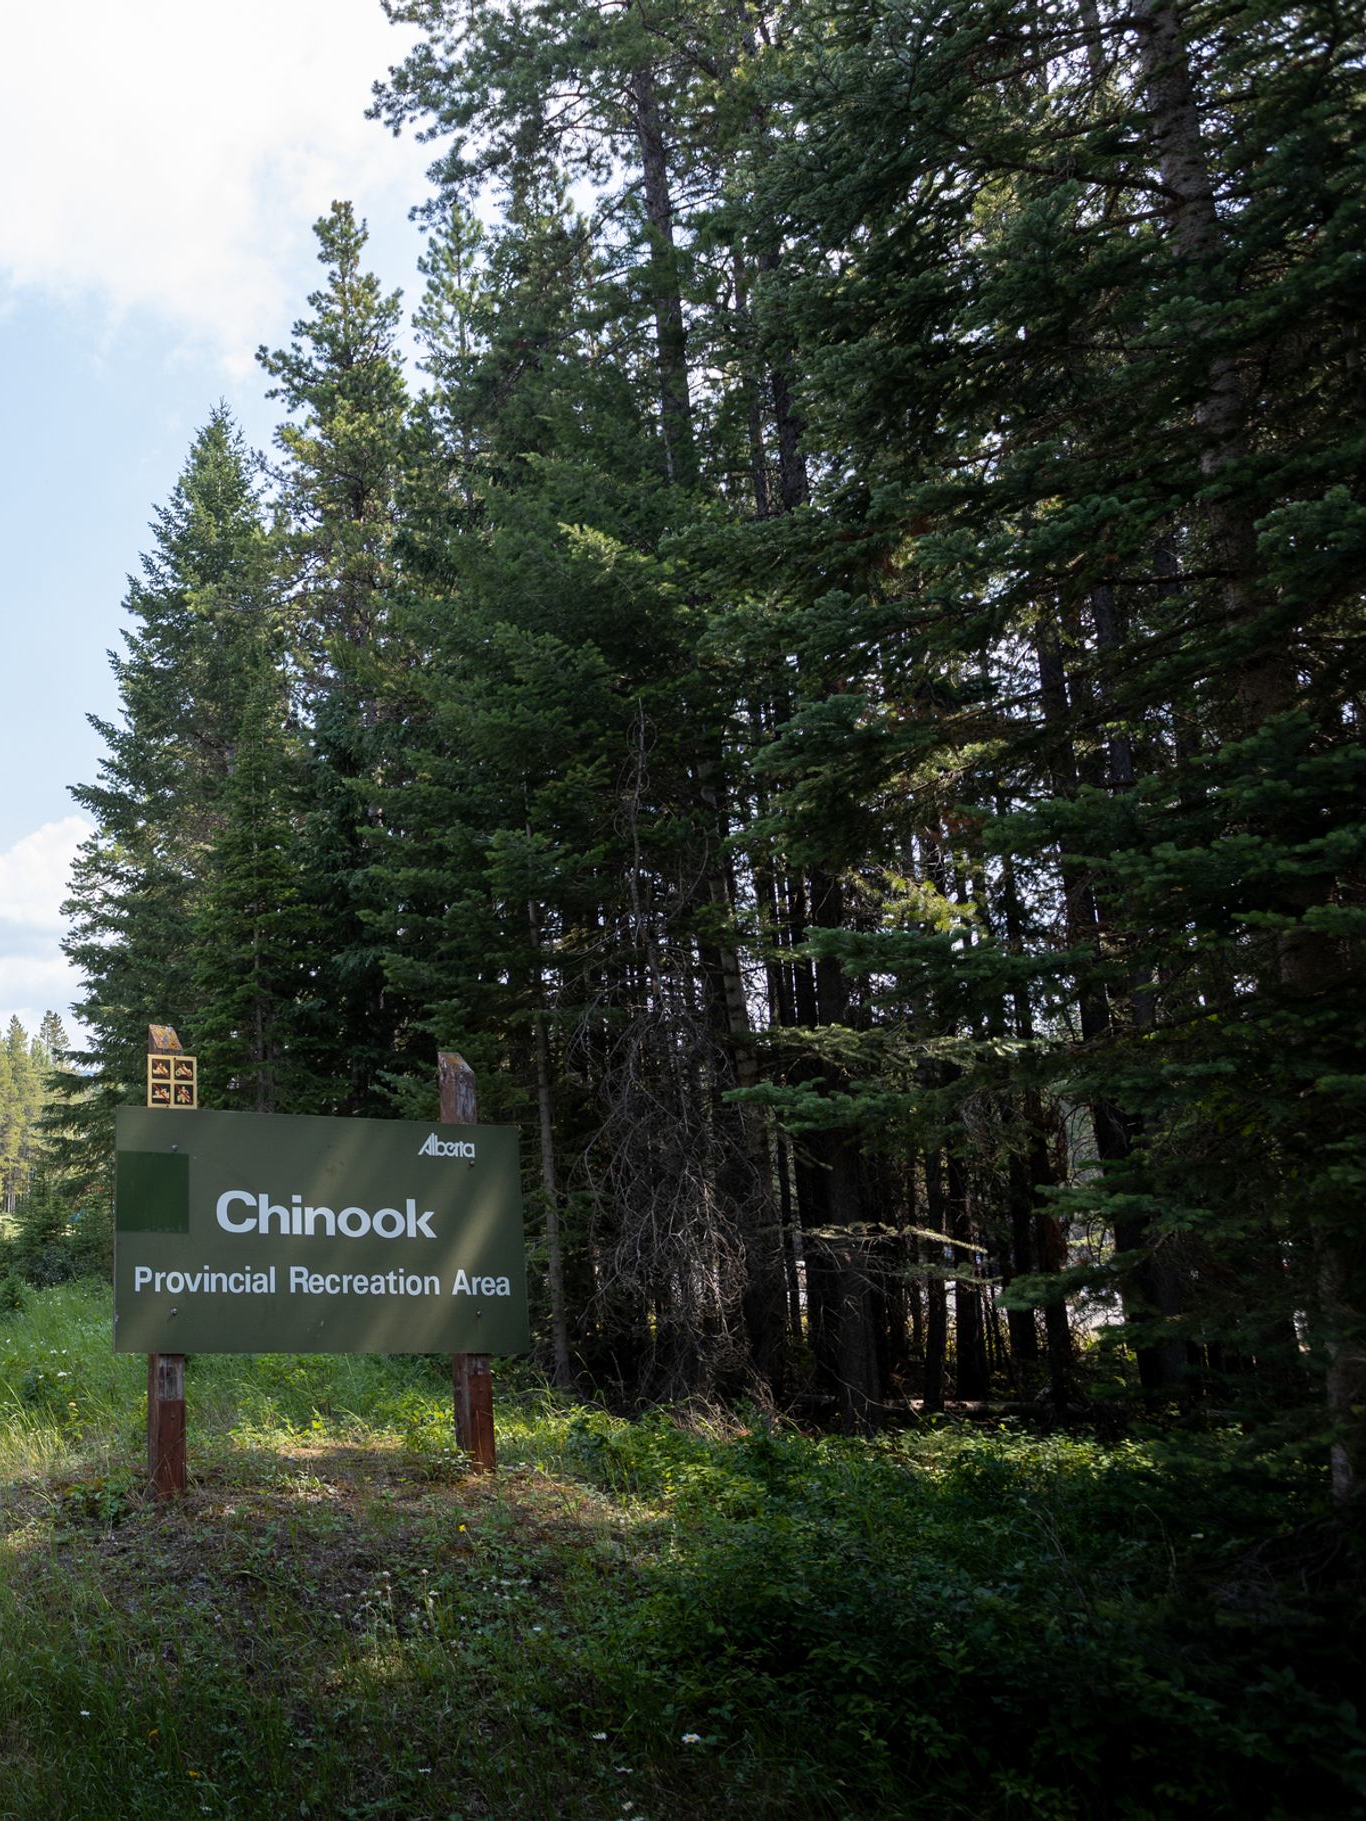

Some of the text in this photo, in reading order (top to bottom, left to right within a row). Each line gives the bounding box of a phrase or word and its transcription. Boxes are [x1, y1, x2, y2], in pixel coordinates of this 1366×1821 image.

[417, 1132, 476, 1158] Alberta
[216, 1190, 437, 1239] Chinook
[134, 1265, 511, 1296] Provincial Recreation Area
